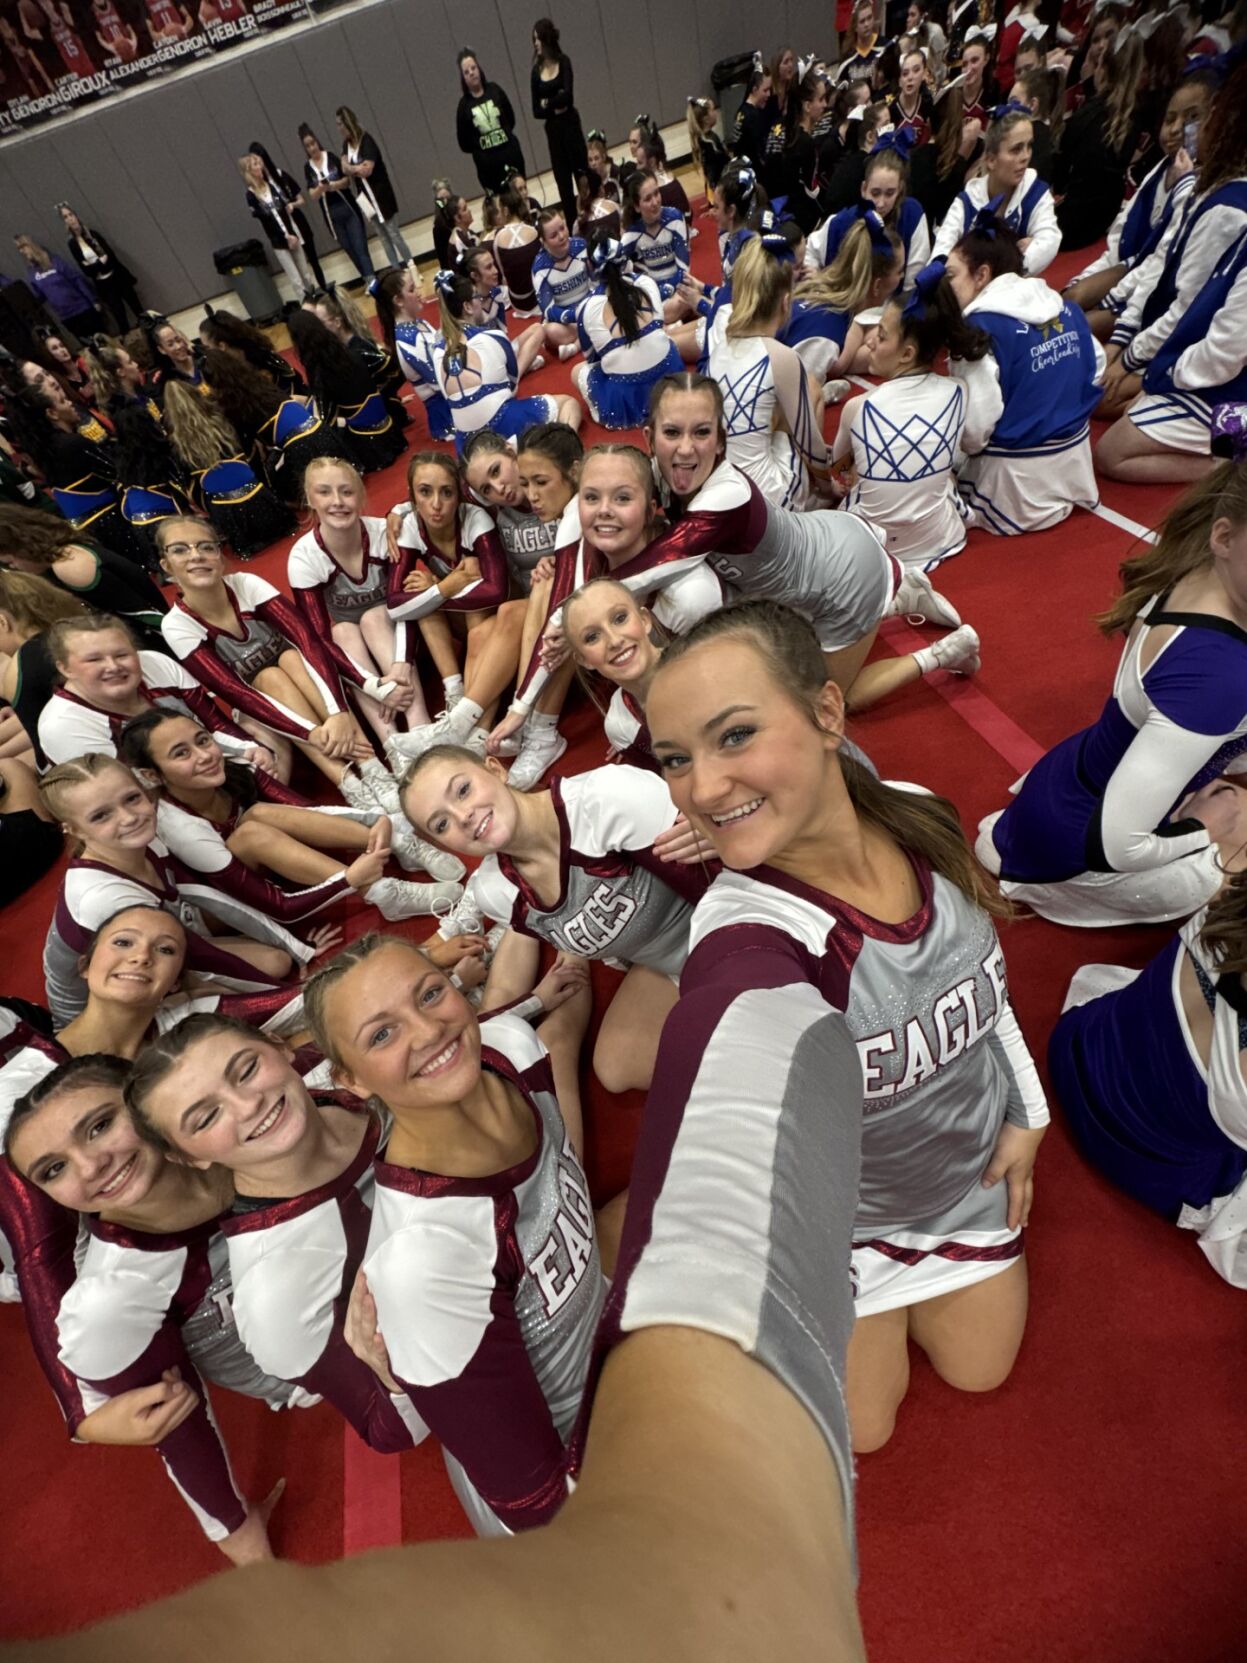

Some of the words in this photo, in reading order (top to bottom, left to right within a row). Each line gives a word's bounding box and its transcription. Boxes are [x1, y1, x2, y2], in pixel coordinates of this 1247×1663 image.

[207, 14, 257, 44] HEBLER
[156, 32, 208, 63] GENDRON
[110, 55, 158, 80] ALEXANDER
[60, 70, 111, 102] GIROUX
[11, 91, 62, 121] GENDRON
[502, 518, 561, 553] EAGLE
[548, 880, 638, 957] GLES
